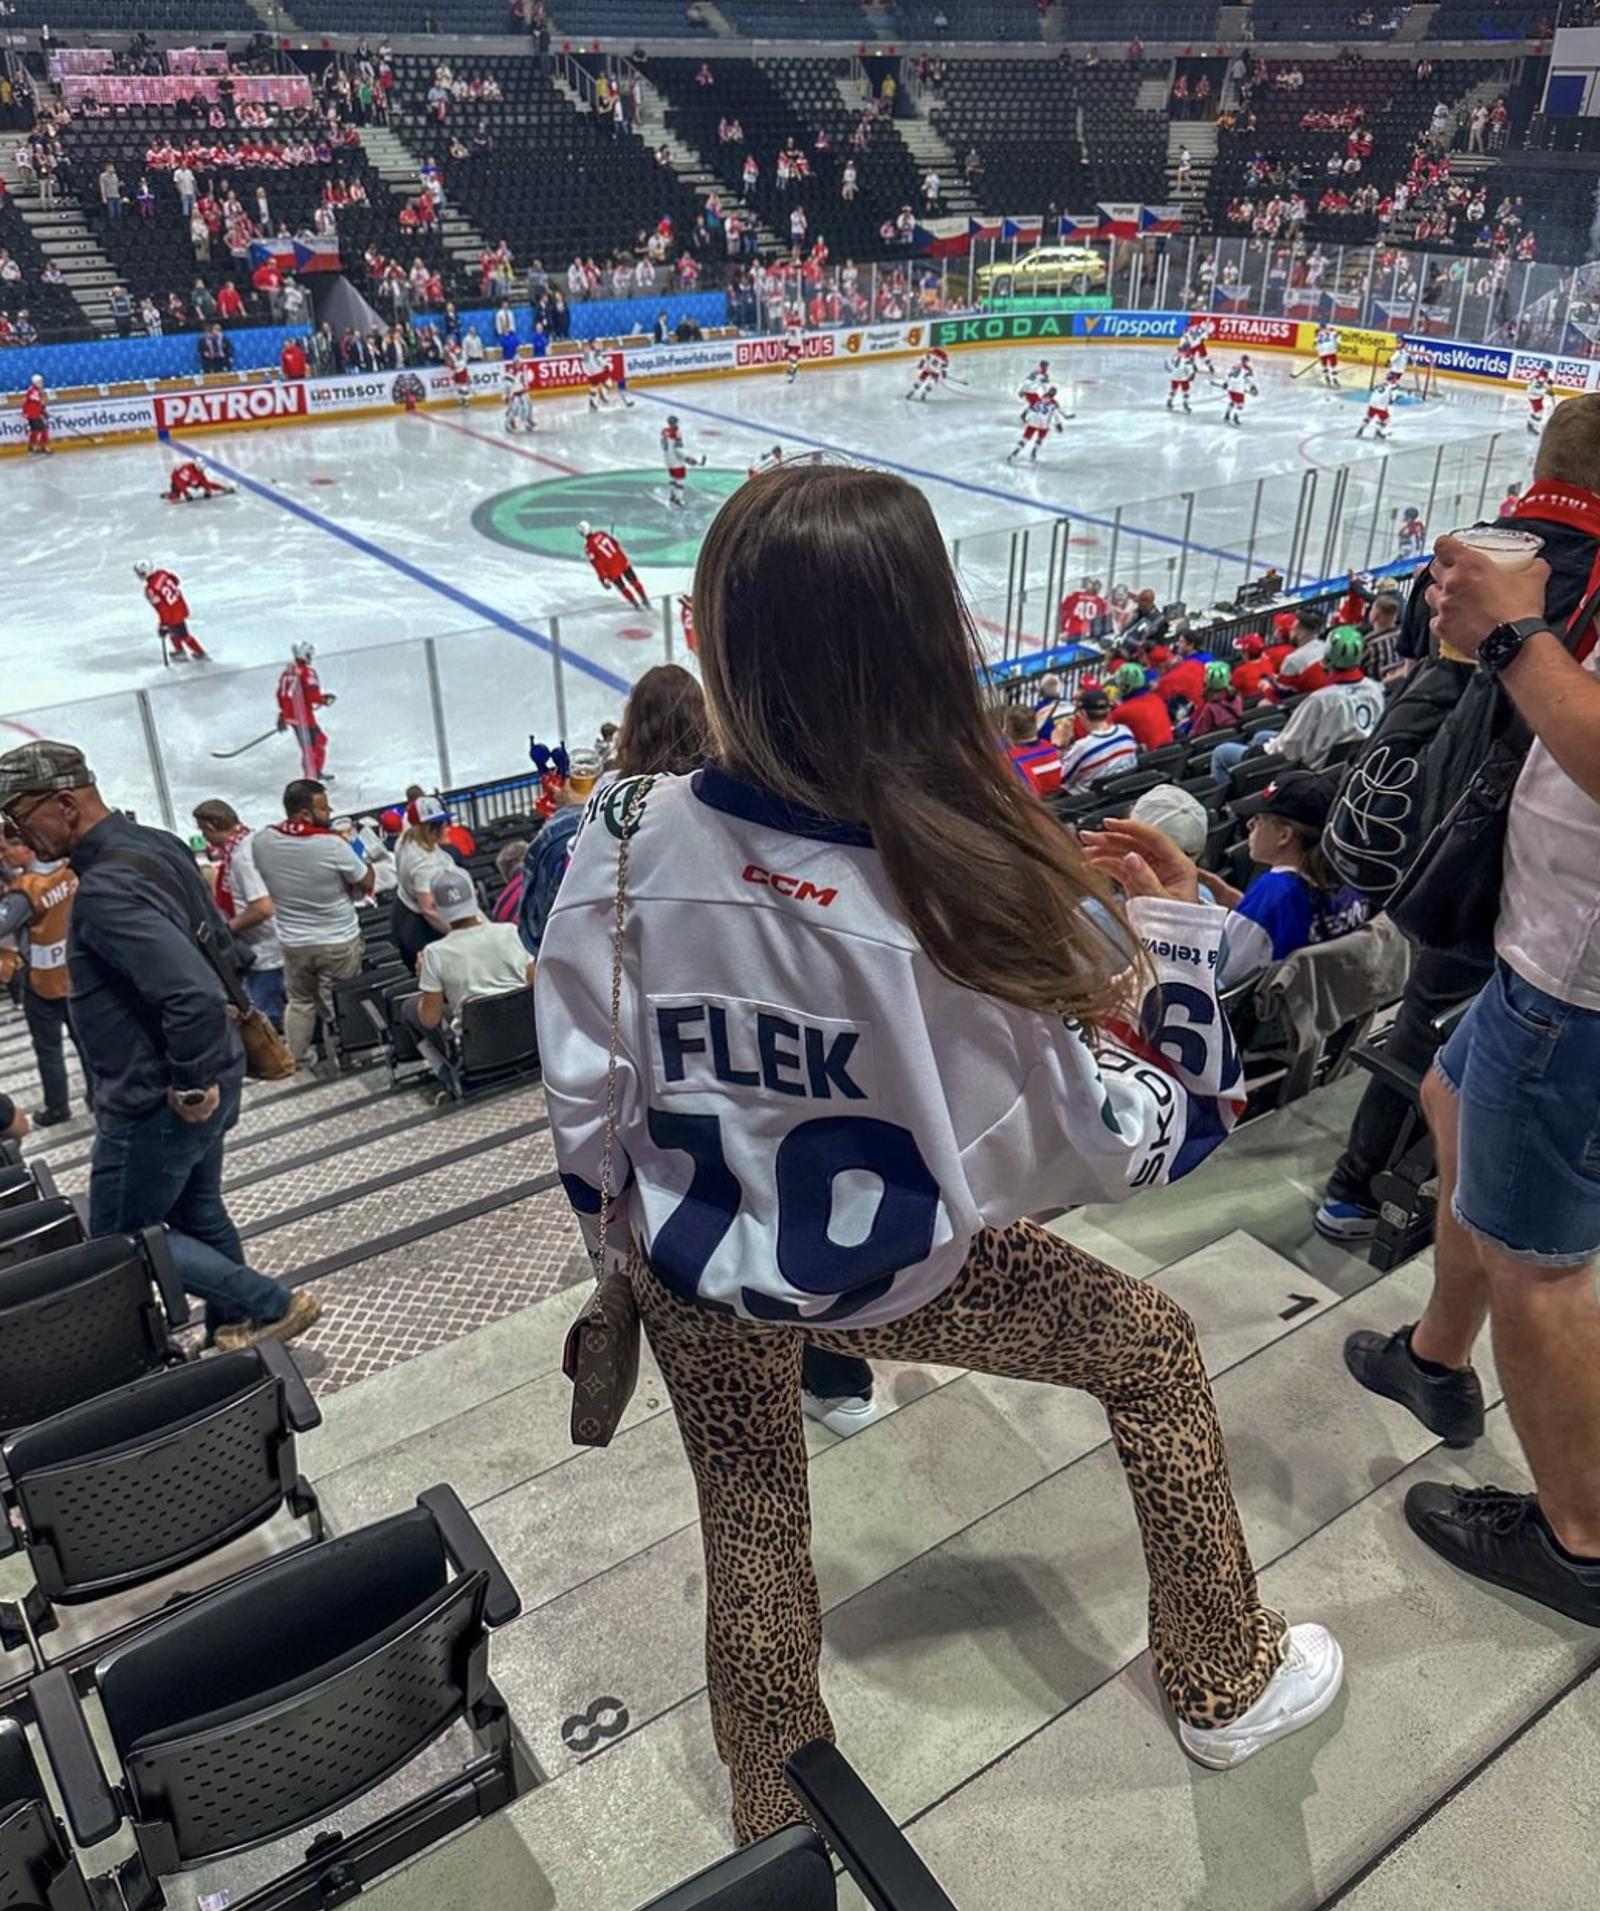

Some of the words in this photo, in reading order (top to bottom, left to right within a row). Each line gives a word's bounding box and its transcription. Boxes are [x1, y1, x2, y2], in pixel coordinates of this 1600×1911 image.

[1103, 315, 1177, 336] Tipsport
[1219, 318, 1290, 338] STRAUSS
[738, 337, 834, 363] BAUUS
[539, 356, 614, 379] STRAS
[1558, 362, 1588, 376] LIQUI
[330, 383, 386, 399] TISSOT
[1556, 374, 1586, 388] MOLY
[163, 386, 299, 427] PATRON
[1074, 601, 1097, 620] 40
[742, 863, 838, 908] CCM
[656, 1005, 868, 1099] FLEK
[561, 1695, 629, 1753] 8
